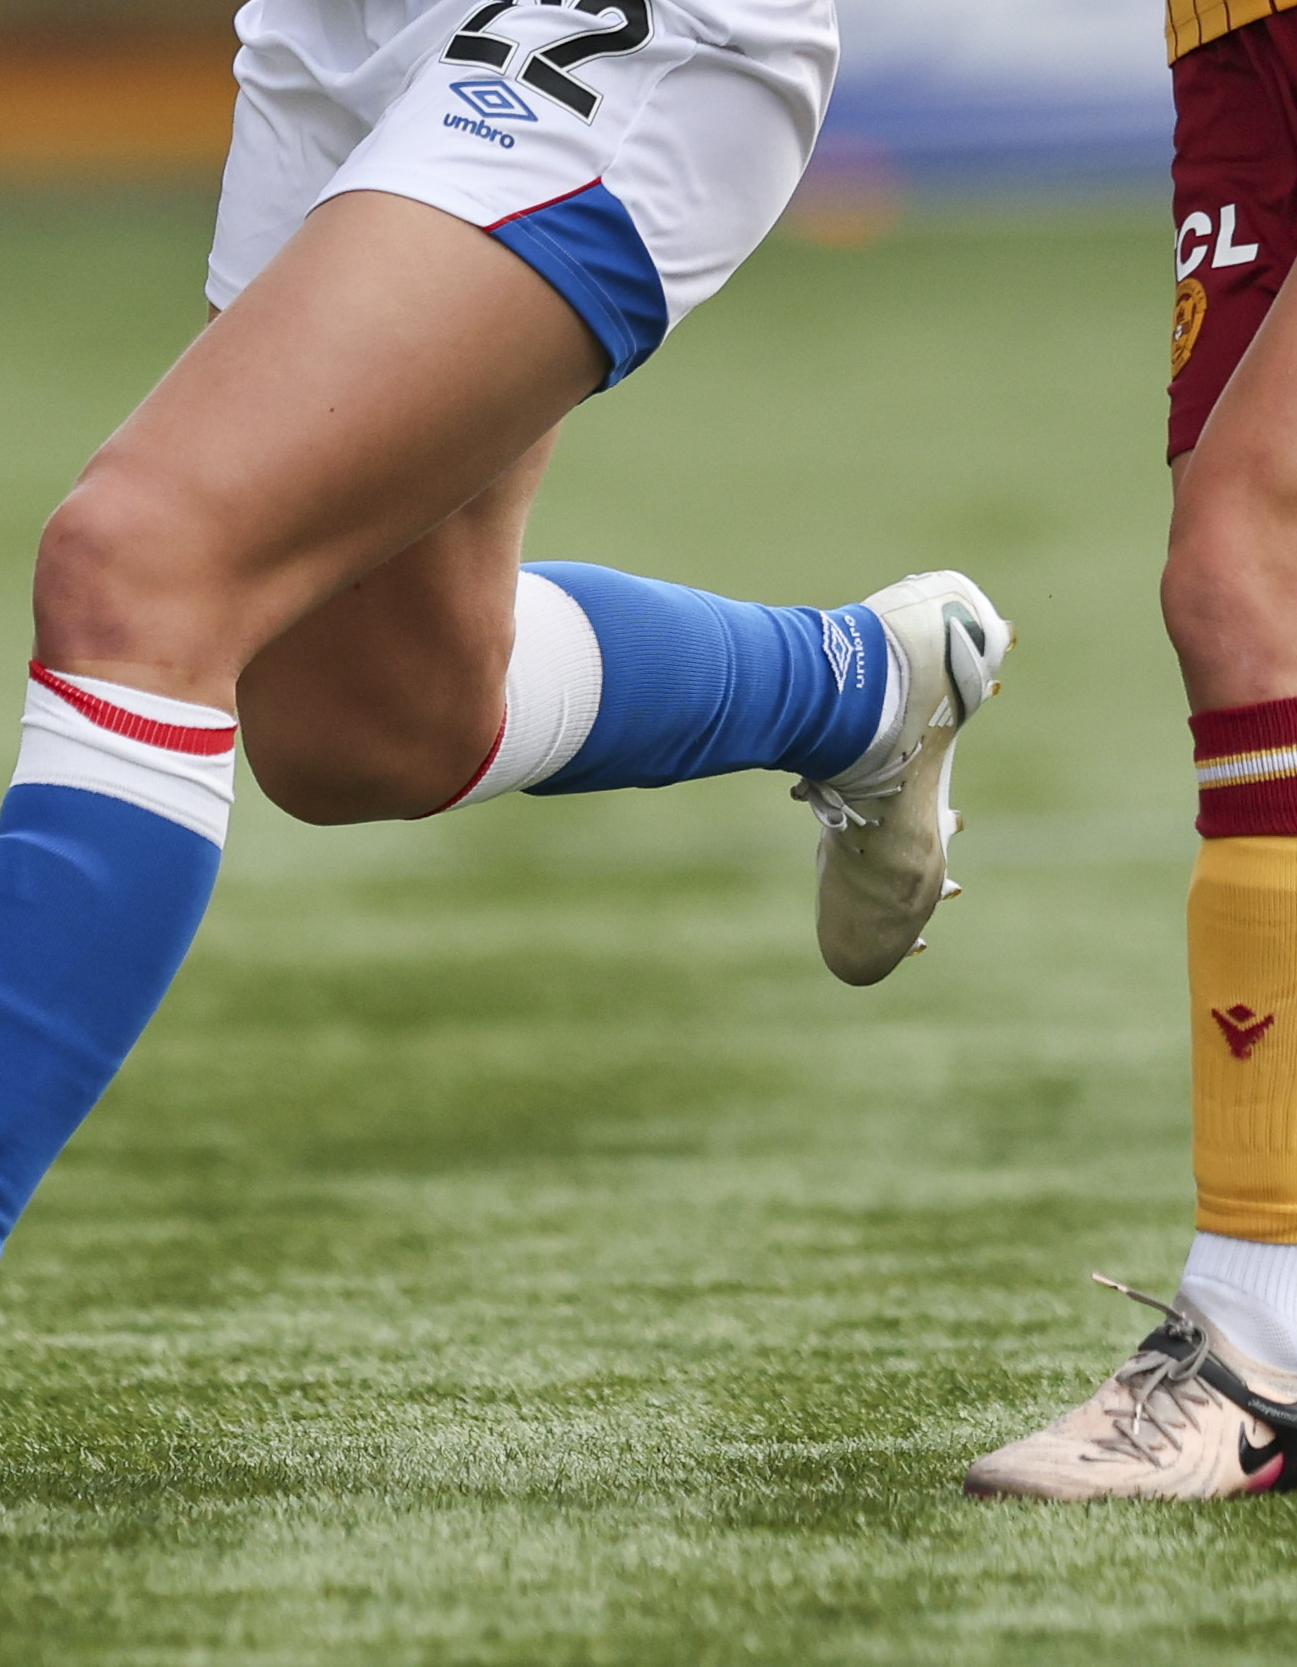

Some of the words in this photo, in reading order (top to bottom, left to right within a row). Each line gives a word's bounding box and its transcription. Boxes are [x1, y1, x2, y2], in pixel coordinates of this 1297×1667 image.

[443, 113, 515, 149] umbro
[1174, 203, 1259, 283] CL
[844, 615, 865, 689] umbro
